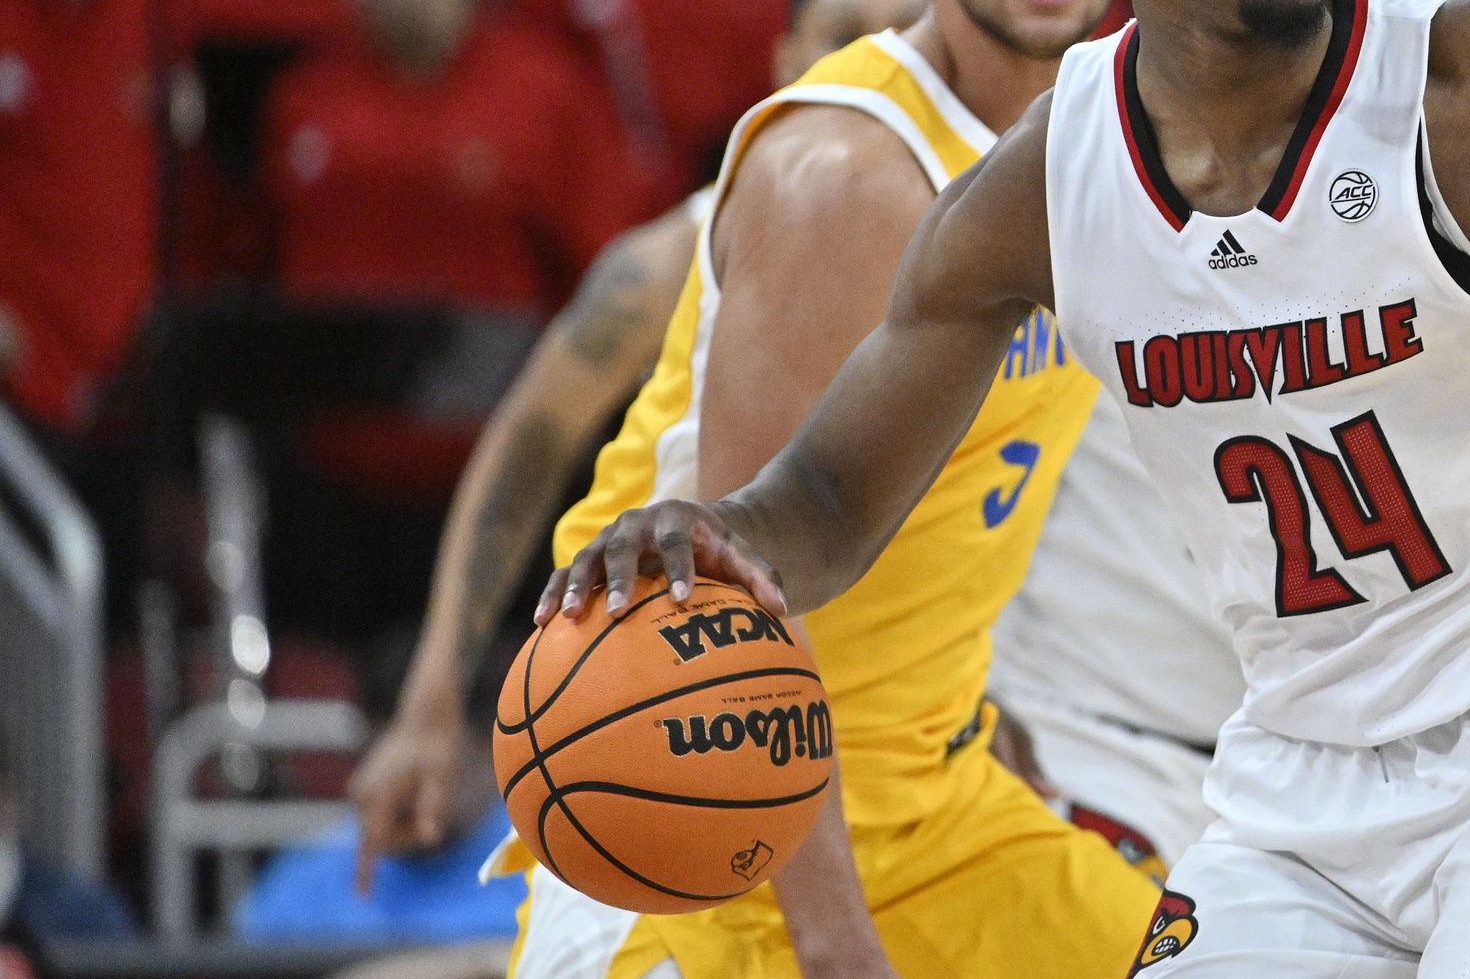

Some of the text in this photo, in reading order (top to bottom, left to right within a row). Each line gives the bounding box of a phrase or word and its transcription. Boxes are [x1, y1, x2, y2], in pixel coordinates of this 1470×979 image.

[1335, 184, 1374, 200] ACC
[1208, 254, 1258, 270] adidas
[1114, 297, 1424, 408] LOUISVILLE
[1213, 409, 1453, 618] 24
[658, 607, 795, 663] NCAA
[663, 700, 833, 767] Wilson
